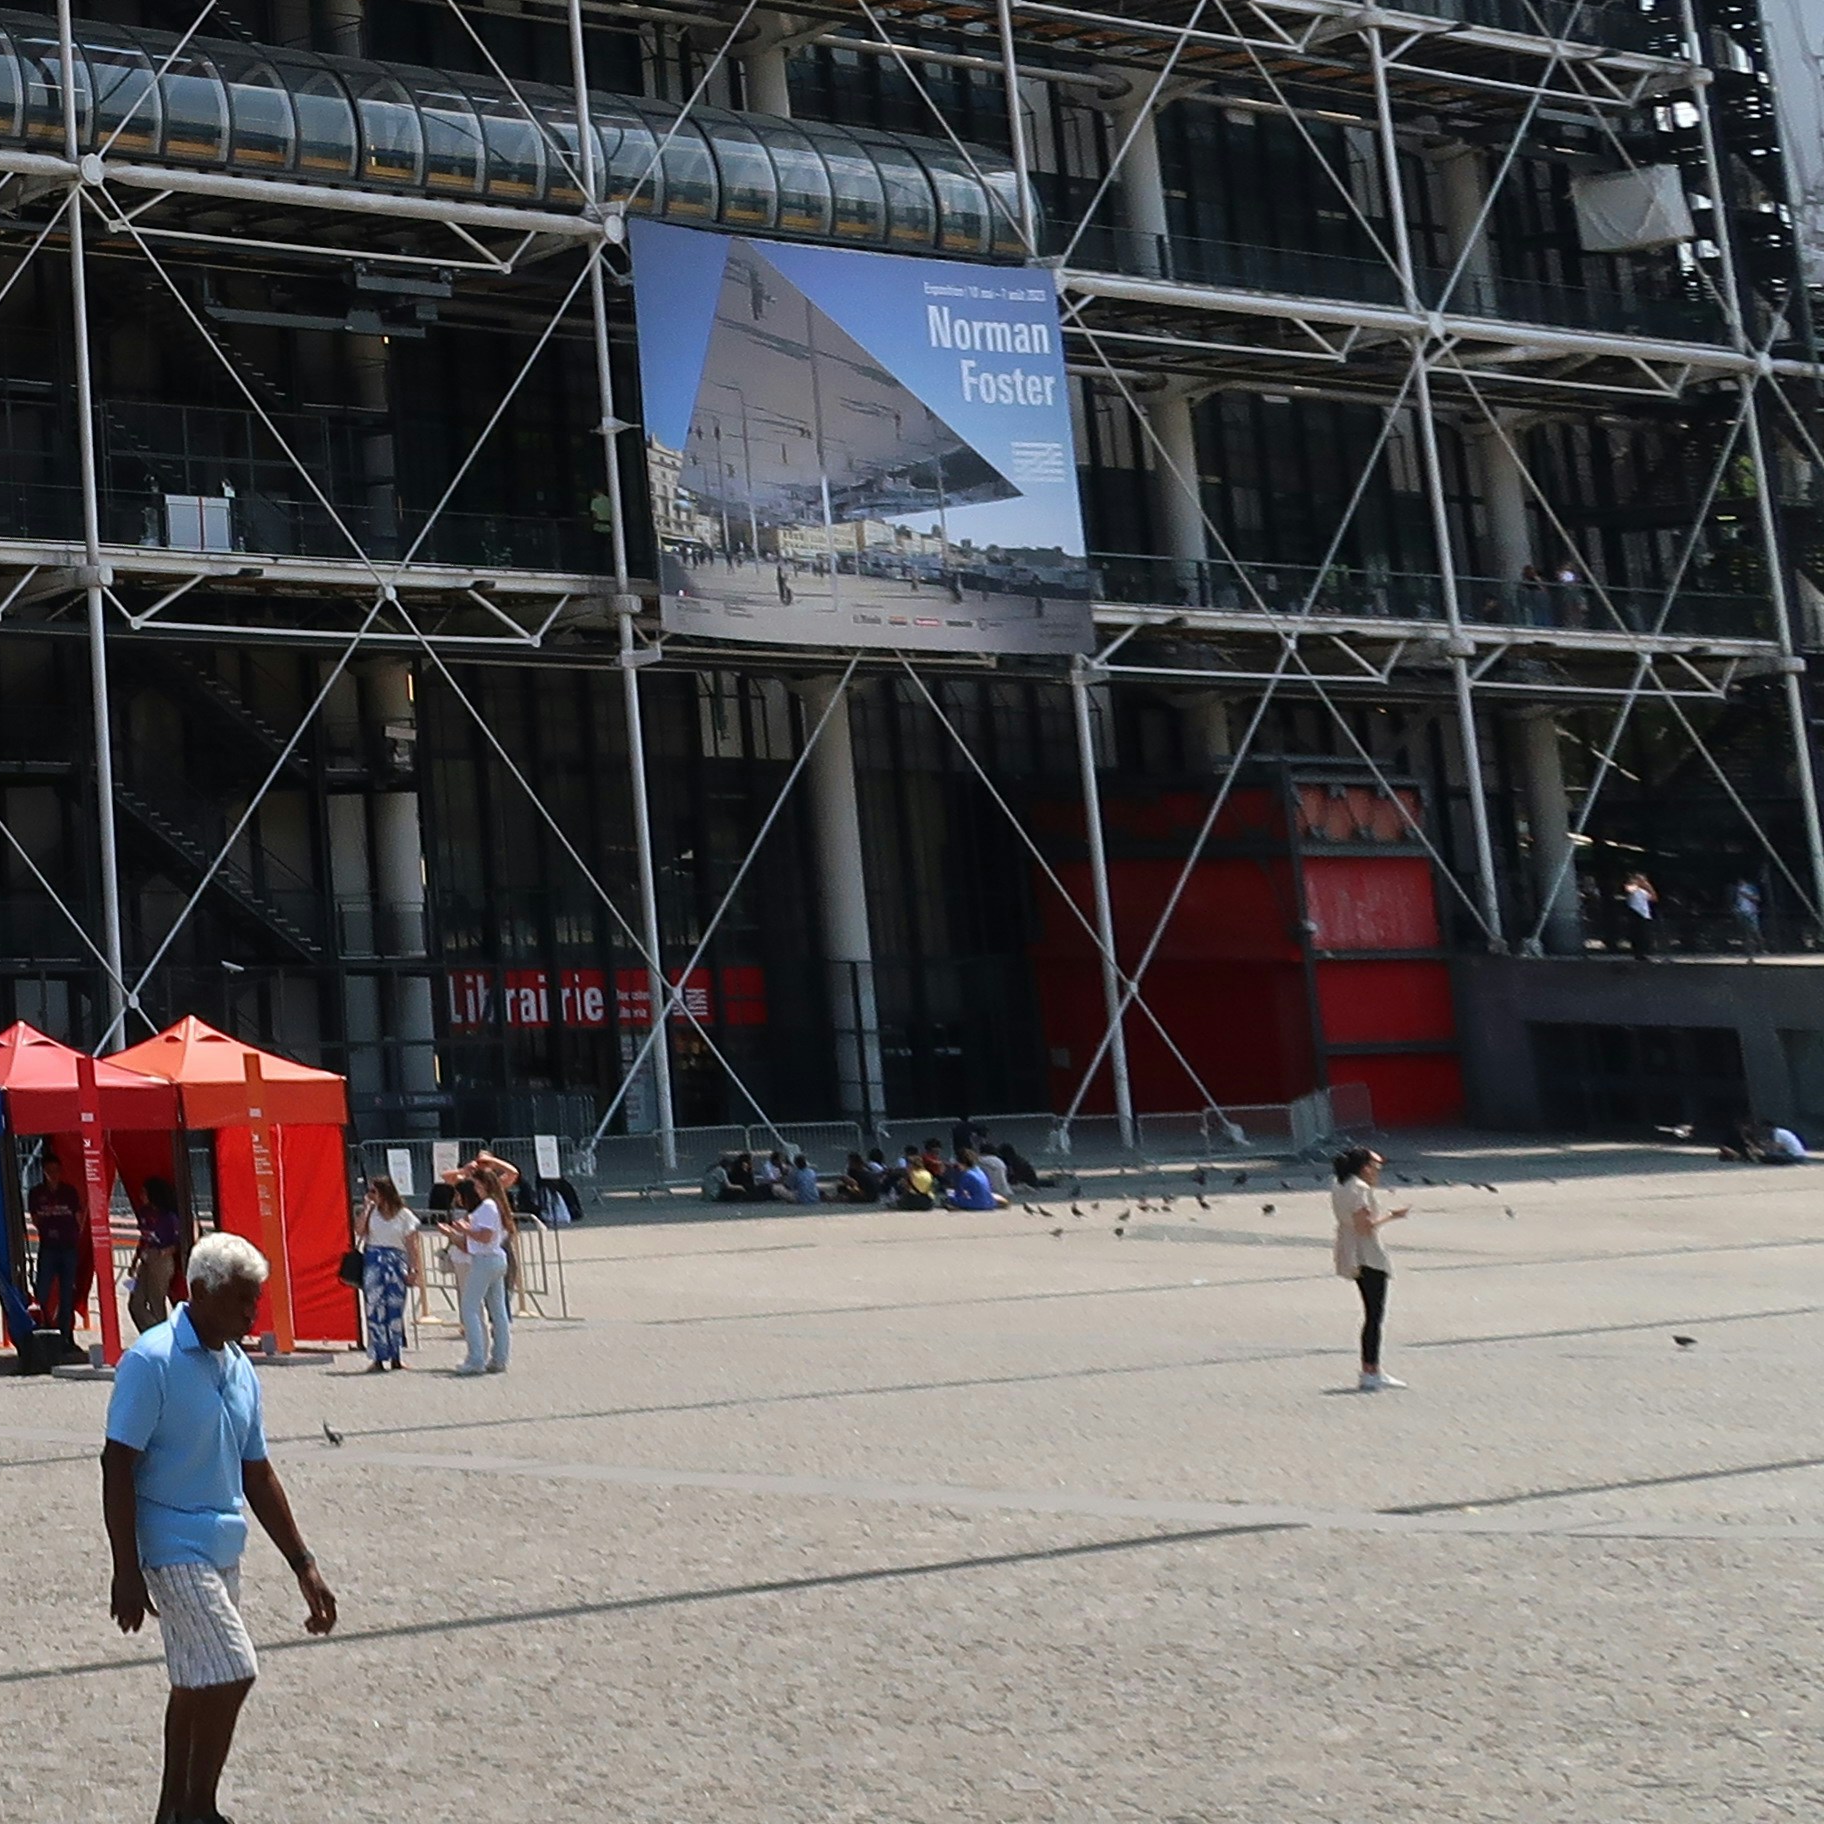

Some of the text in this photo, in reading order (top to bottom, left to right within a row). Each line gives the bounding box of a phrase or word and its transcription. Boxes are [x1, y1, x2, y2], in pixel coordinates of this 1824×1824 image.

[927, 305, 1051, 354] Norman
[960, 359, 1056, 406] Foster
[448, 973, 605, 1024] Librairie
